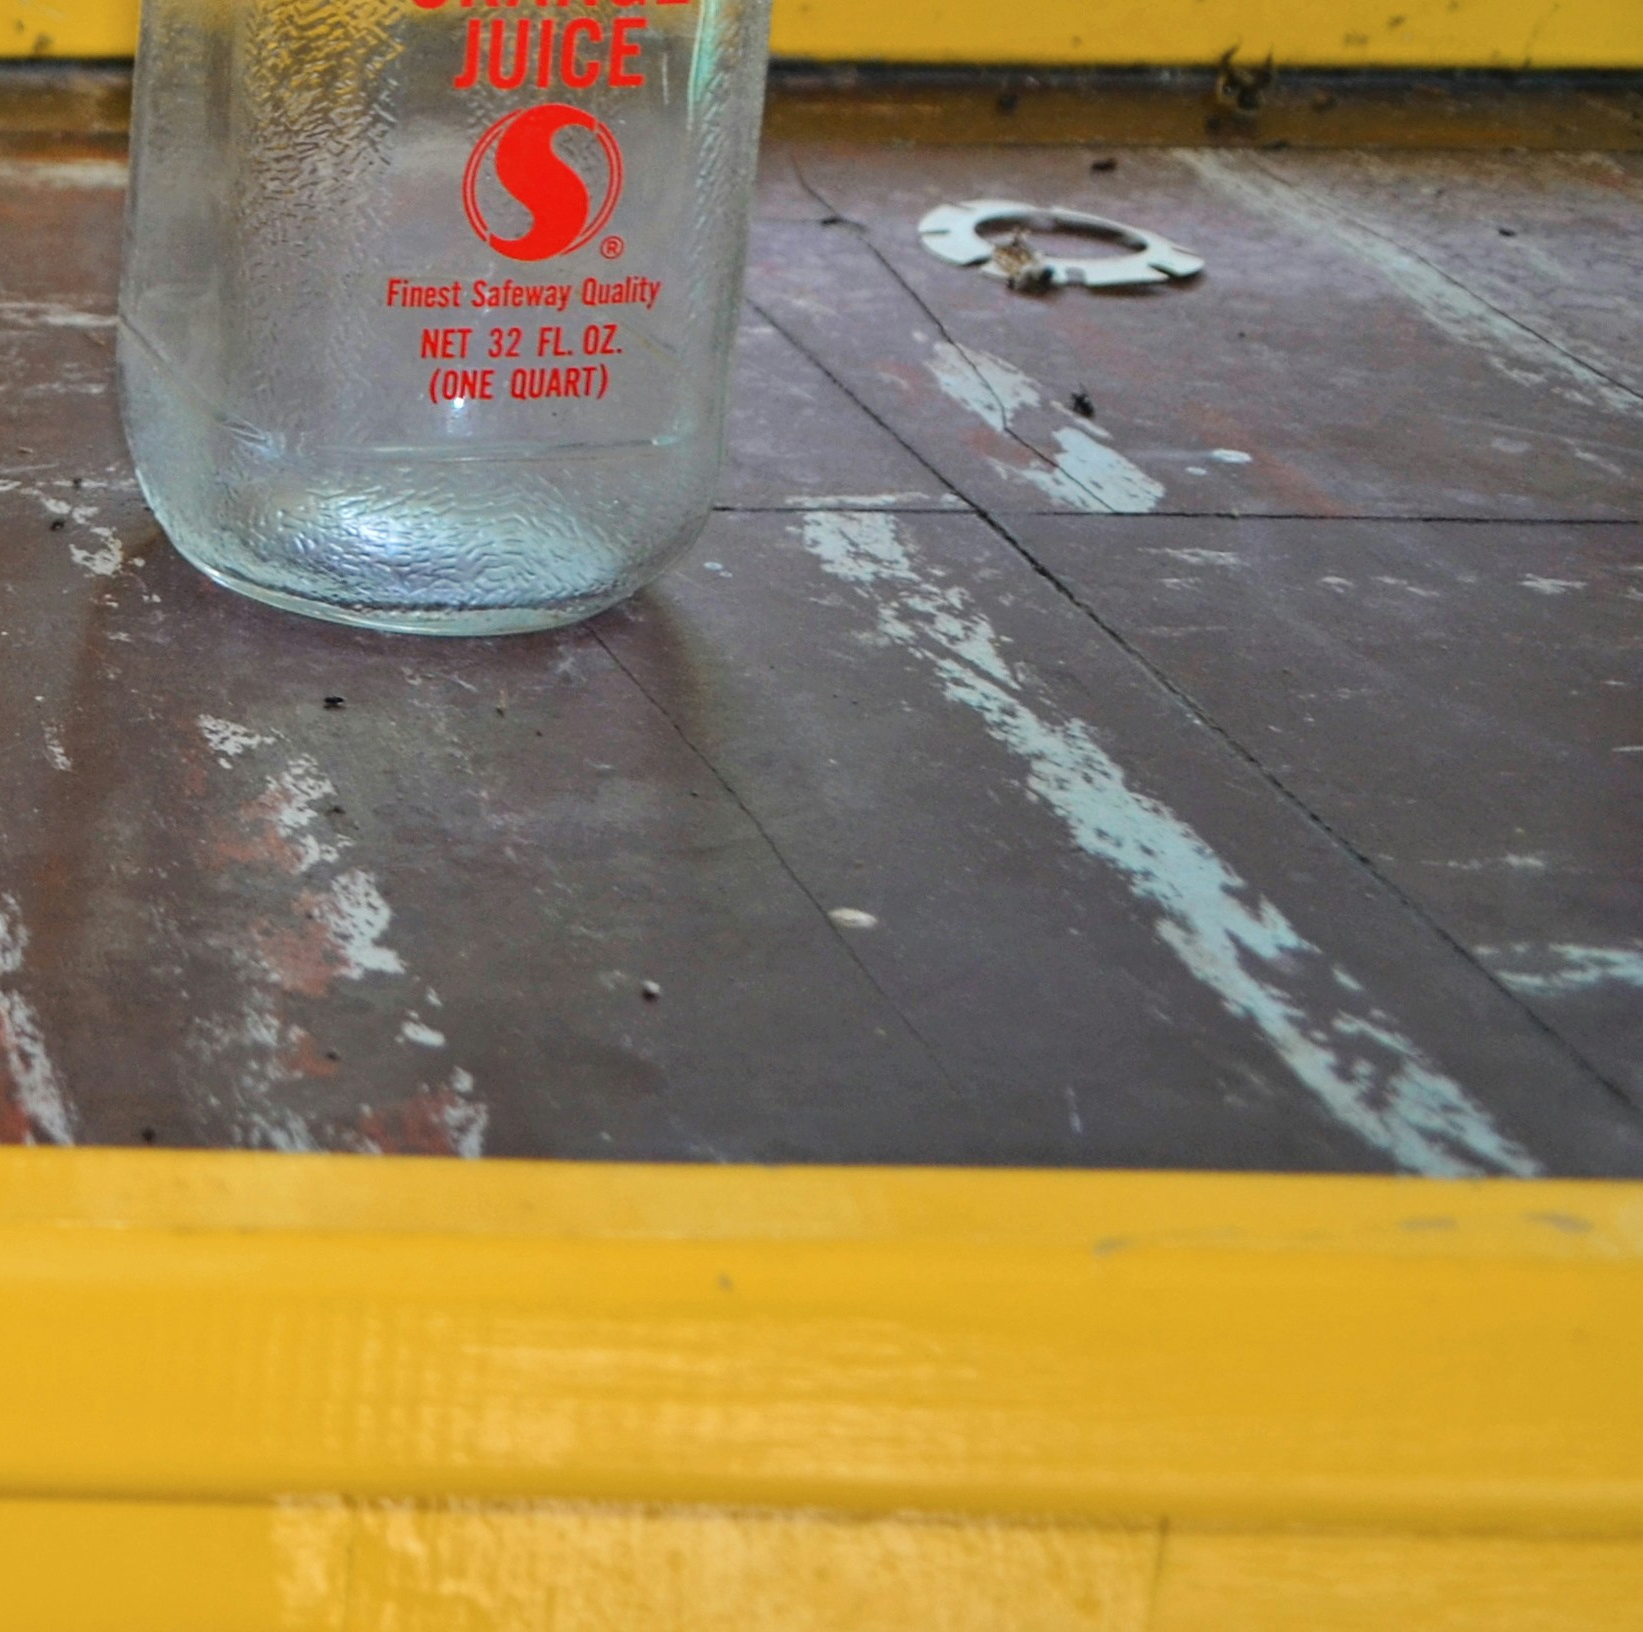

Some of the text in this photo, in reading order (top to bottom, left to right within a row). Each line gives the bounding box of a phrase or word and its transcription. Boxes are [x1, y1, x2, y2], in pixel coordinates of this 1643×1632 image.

[452, 17, 649, 91] JUICE
[386, 275, 662, 312] Finest Safeway Quality
[420, 323, 624, 359] NET 32 FL. OZ.
[429, 363, 610, 404] (ONE QUART)
